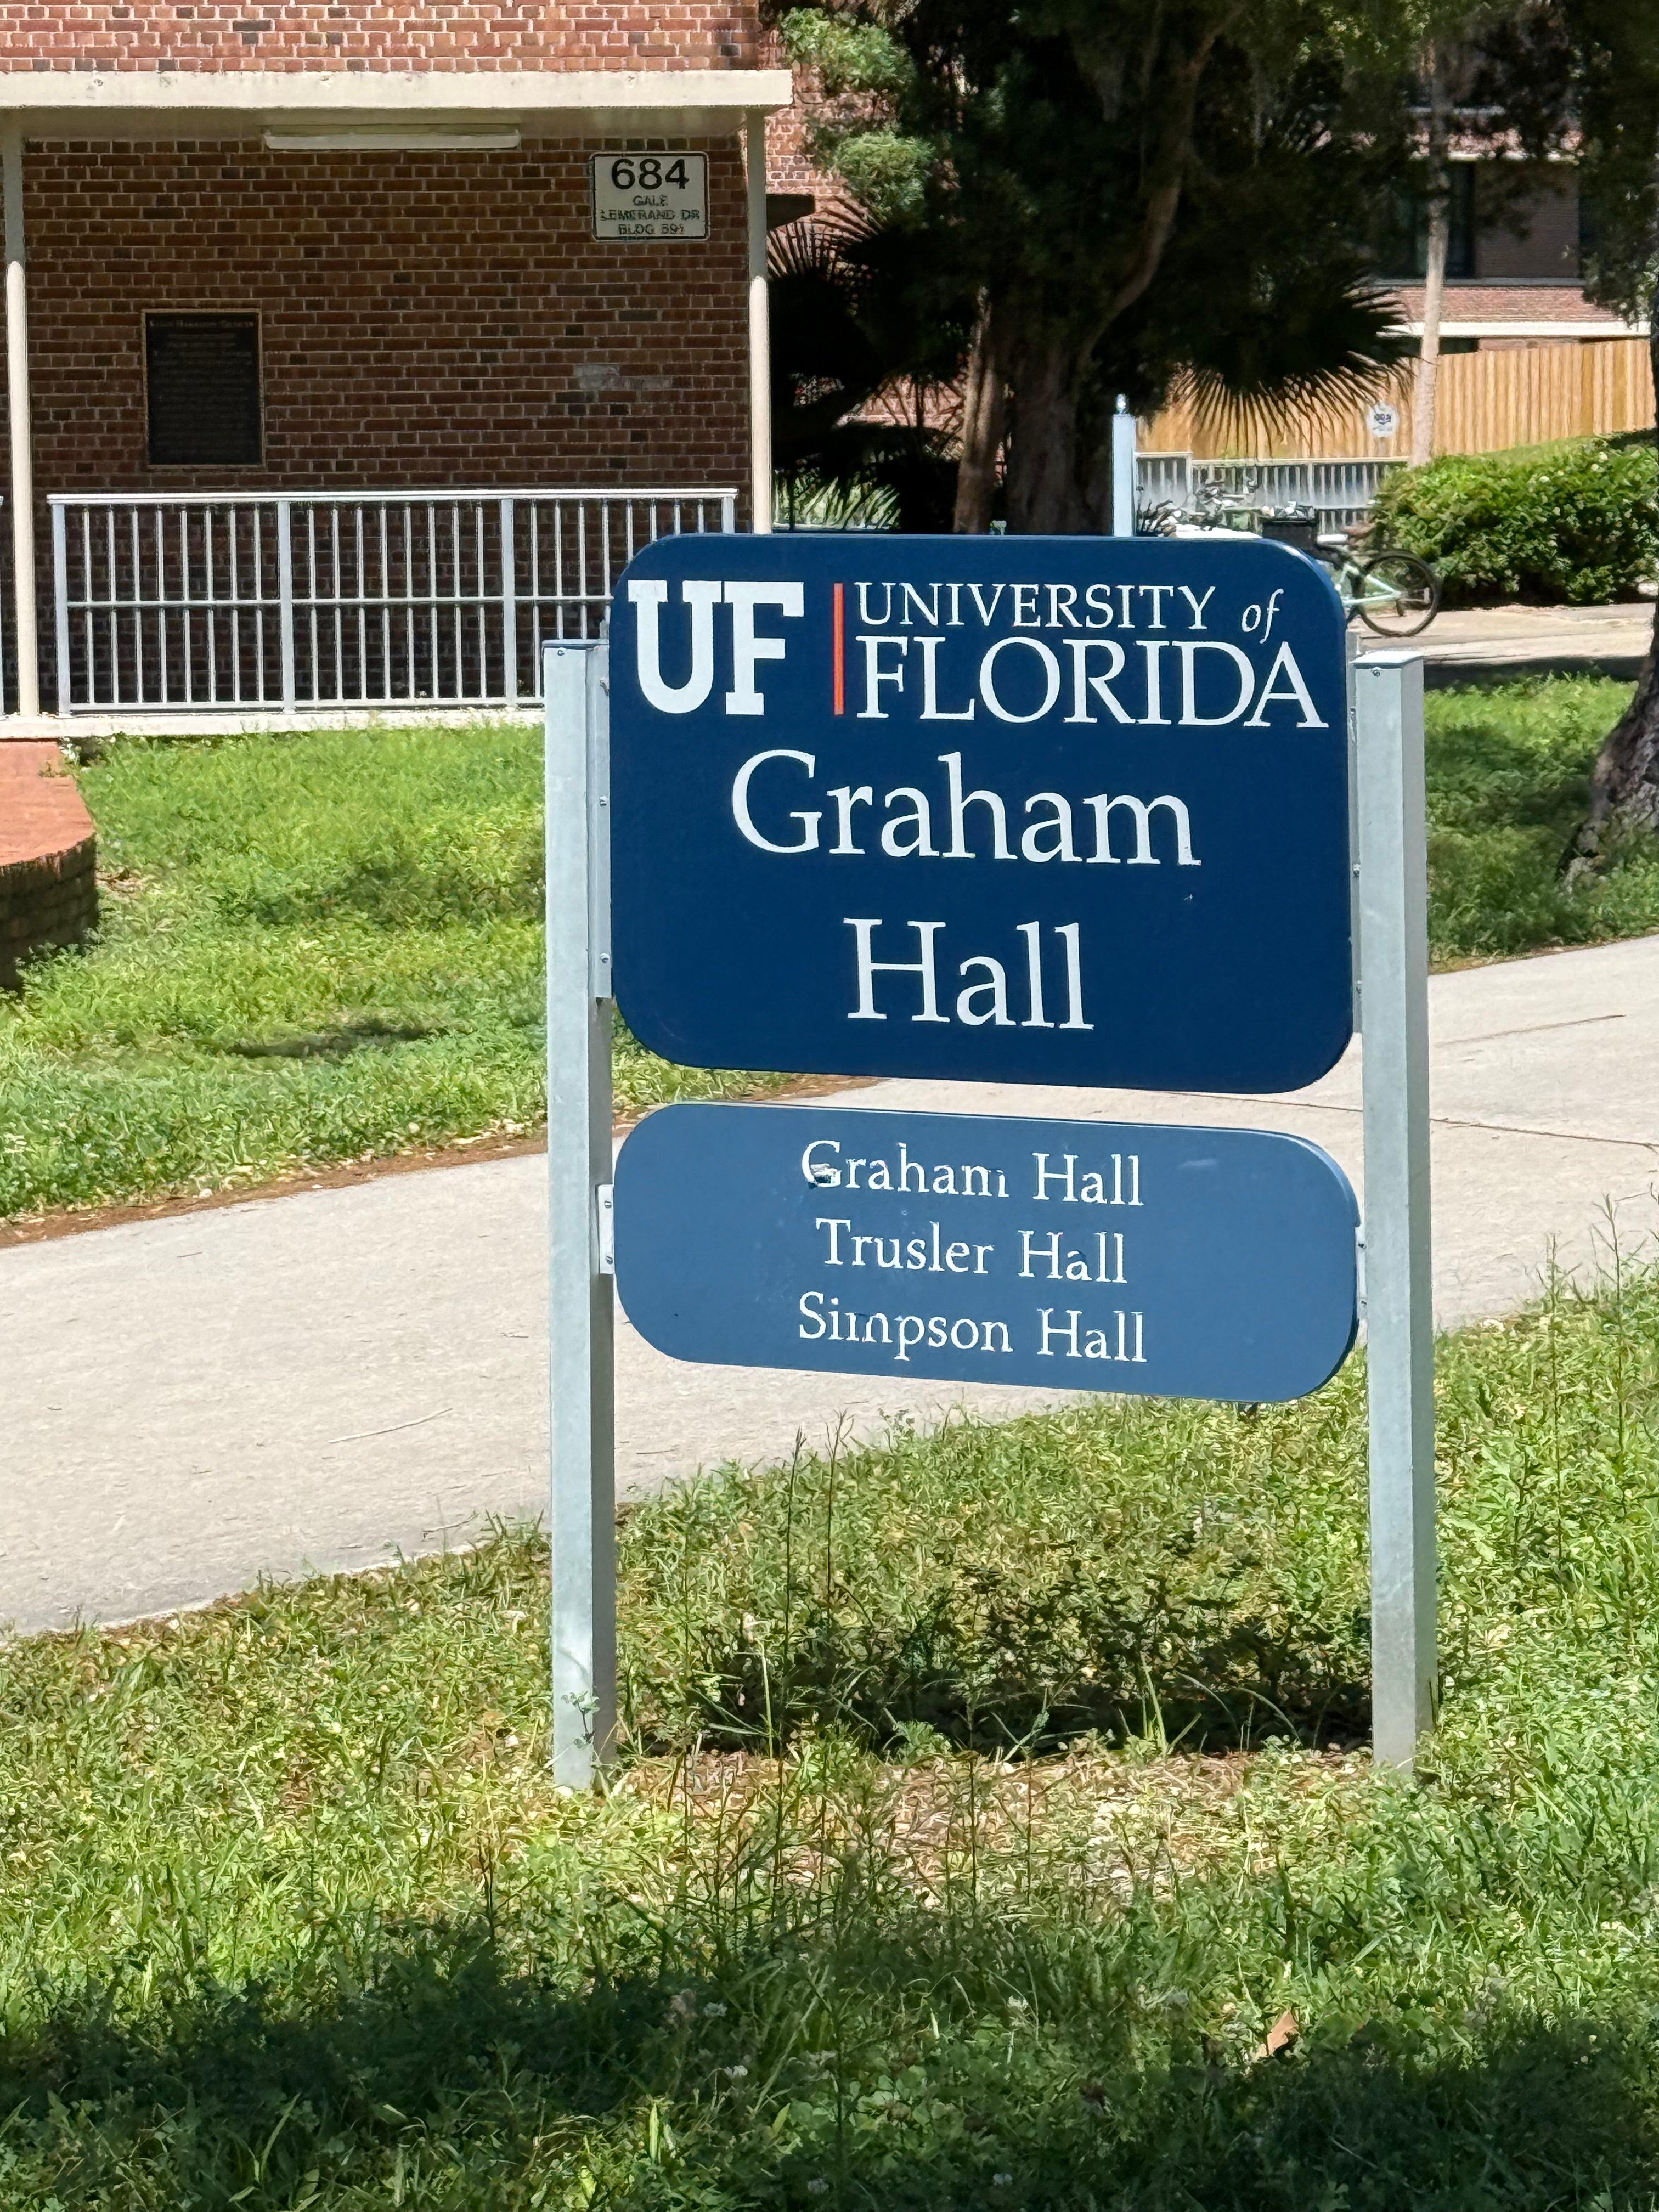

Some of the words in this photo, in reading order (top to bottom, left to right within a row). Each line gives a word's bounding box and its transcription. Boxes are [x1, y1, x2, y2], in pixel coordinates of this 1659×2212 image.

[611, 158, 690, 190] 684
[633, 195, 668, 206] GALE
[601, 209, 675, 221] LEMERAND
[681, 209, 701, 221] DR
[618, 223, 655, 235] BLDG
[627, 579, 805, 716] UF
[854, 582, 1216, 630] UNIVERSITY
[1241, 588, 1284, 644] of
[855, 635, 1330, 729] FLORIDA
[731, 749, 1202, 866] Graham
[843, 917, 1095, 1031] Hall
[801, 1139, 1010, 1198] Graham
[1031, 1152, 1144, 1206] Hall
[815, 1217, 995, 1274] Trusler
[1017, 1229, 1128, 1284] Hall
[799, 1290, 1014, 1362] Simpson
[1036, 1307, 1148, 1363] Hall
